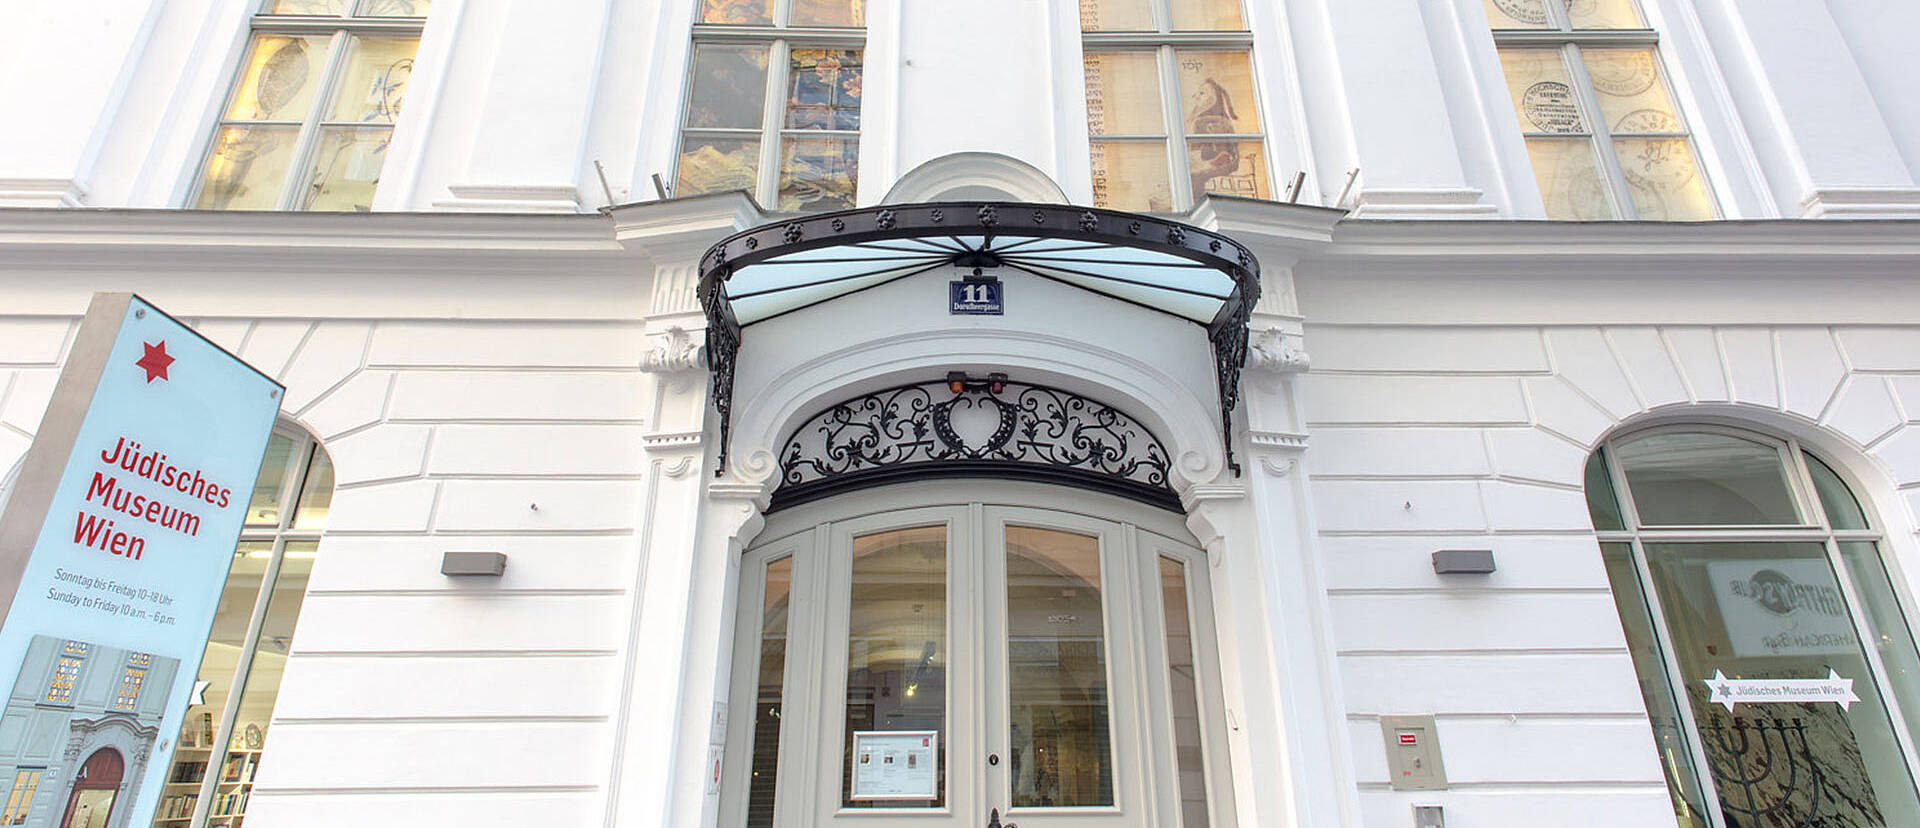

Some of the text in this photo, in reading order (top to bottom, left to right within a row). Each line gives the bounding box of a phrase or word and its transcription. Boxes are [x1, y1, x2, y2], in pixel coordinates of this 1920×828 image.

[963, 284, 990, 303] 11
[101, 437, 232, 509] Jüdisches
[86, 471, 200, 536] Museum
[74, 511, 145, 561] Wien
[47, 587, 82, 607] Sunday
[82, 596, 93, 607] to
[93, 598, 120, 615] Friday
[120, 604, 131, 616] 10
[130, 608, 146, 619] a.m.
[153, 612, 161, 623] 6
[54, 568, 93, 589] Sonntag
[93, 578, 107, 591] bis
[107, 581, 136, 600] Freitag
[160, 593, 174, 606] Uhr
[1736, 685, 1846, 697] Jüdisches Museum Wien
